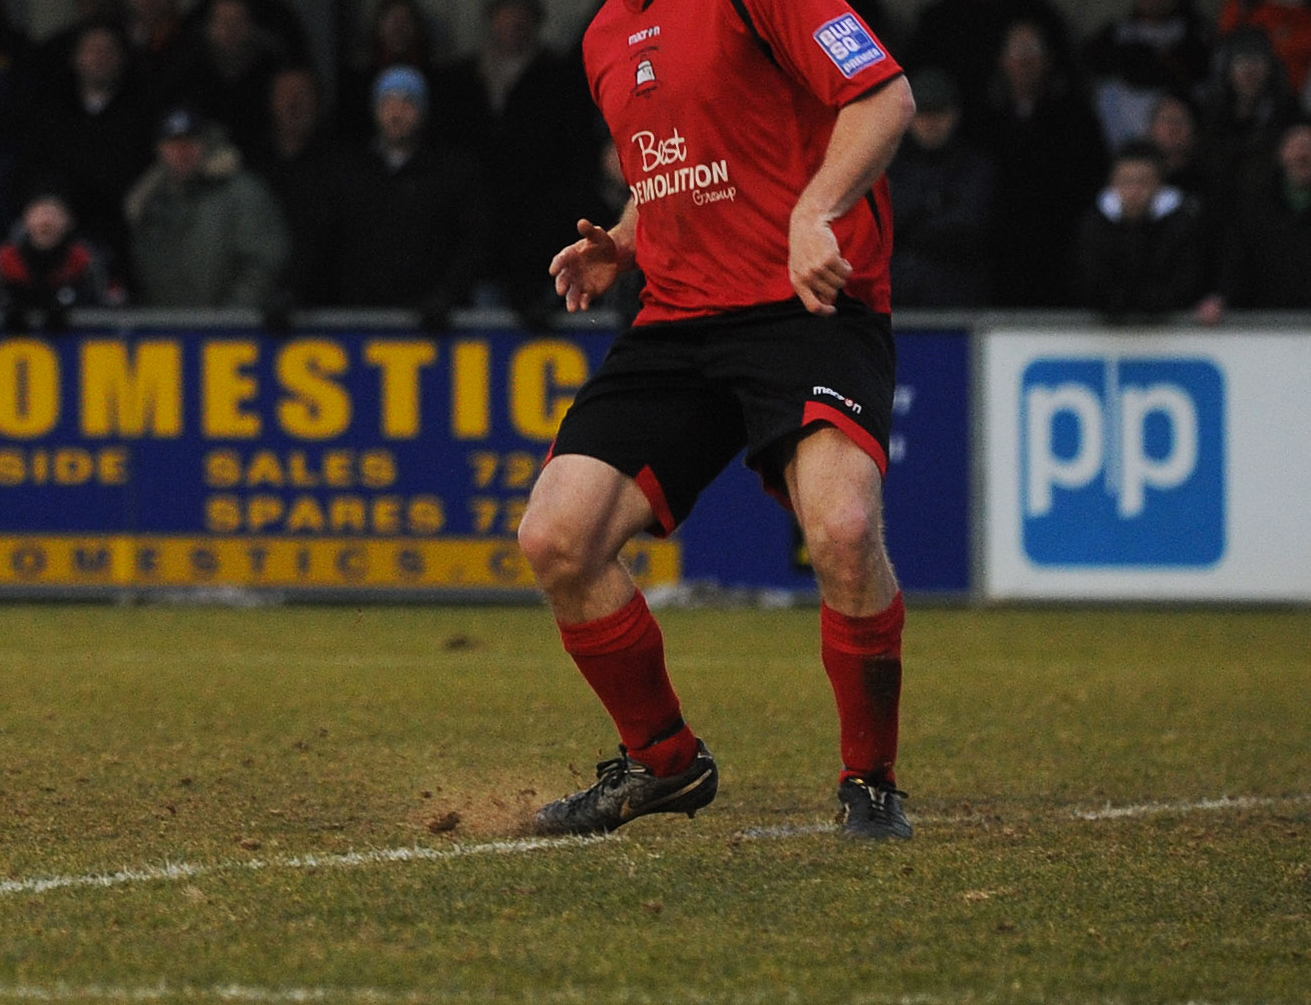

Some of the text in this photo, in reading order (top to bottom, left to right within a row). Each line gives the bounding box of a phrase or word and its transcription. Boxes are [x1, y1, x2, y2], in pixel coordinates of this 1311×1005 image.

[819, 17, 859, 48] BLUE
[829, 36, 861, 61] SQ
[631, 127, 687, 172] Best
[692, 187, 736, 206] Group
[204, 449, 398, 487] SALES
[204, 498, 445, 533] SPARES
